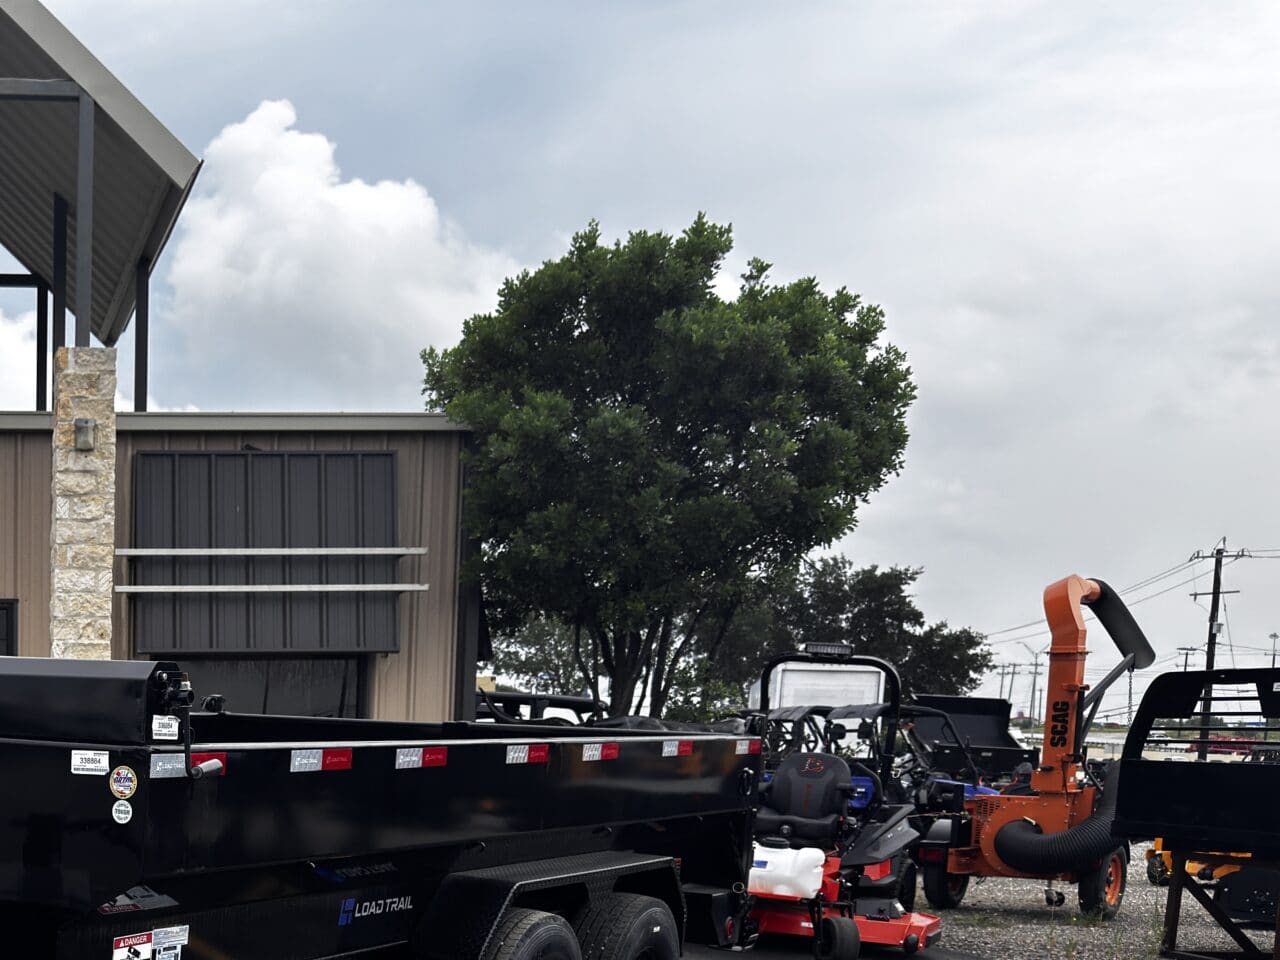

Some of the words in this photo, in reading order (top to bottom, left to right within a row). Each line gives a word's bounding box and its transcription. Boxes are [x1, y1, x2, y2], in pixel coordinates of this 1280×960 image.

[1050, 701, 1070, 747] SCAG
[355, 900, 384, 917] LOAD
[386, 896, 413, 912] TRAIL
[124, 935, 148, 946] DANGER
